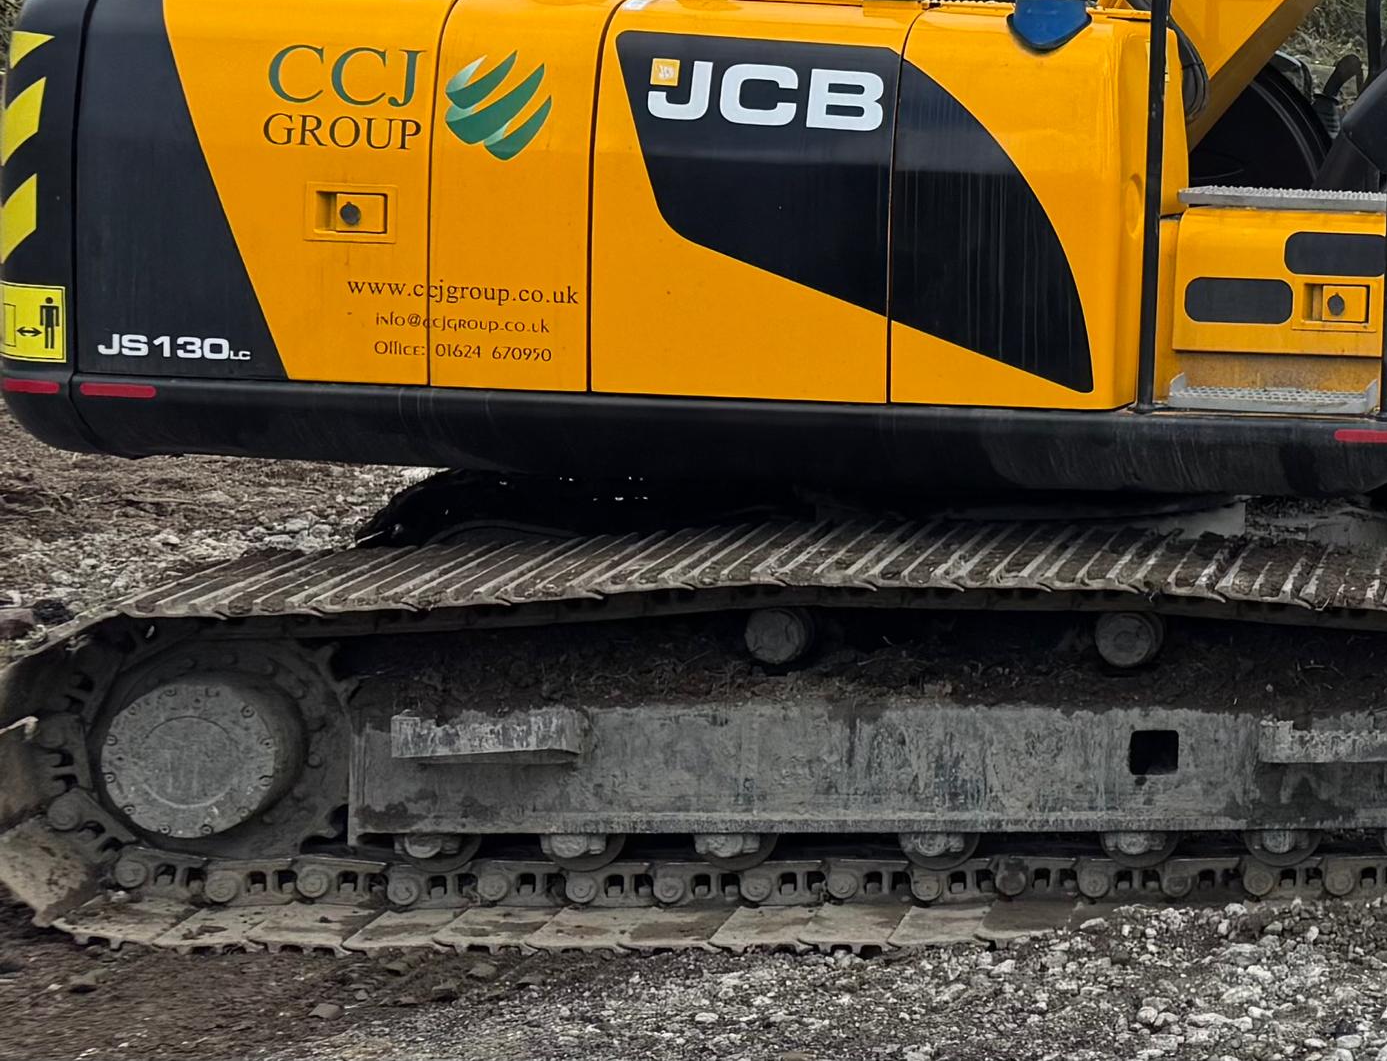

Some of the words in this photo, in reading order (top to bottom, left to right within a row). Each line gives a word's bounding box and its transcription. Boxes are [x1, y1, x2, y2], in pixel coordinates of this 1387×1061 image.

[268, 44, 427, 107] CCJ
[647, 60, 884, 132] JCB
[263, 113, 422, 150] GROUP
[347, 279, 579, 306] www.ccjgroup.co.uk
[435, 342, 481, 358] 01624
[492, 345, 552, 362] 670950
